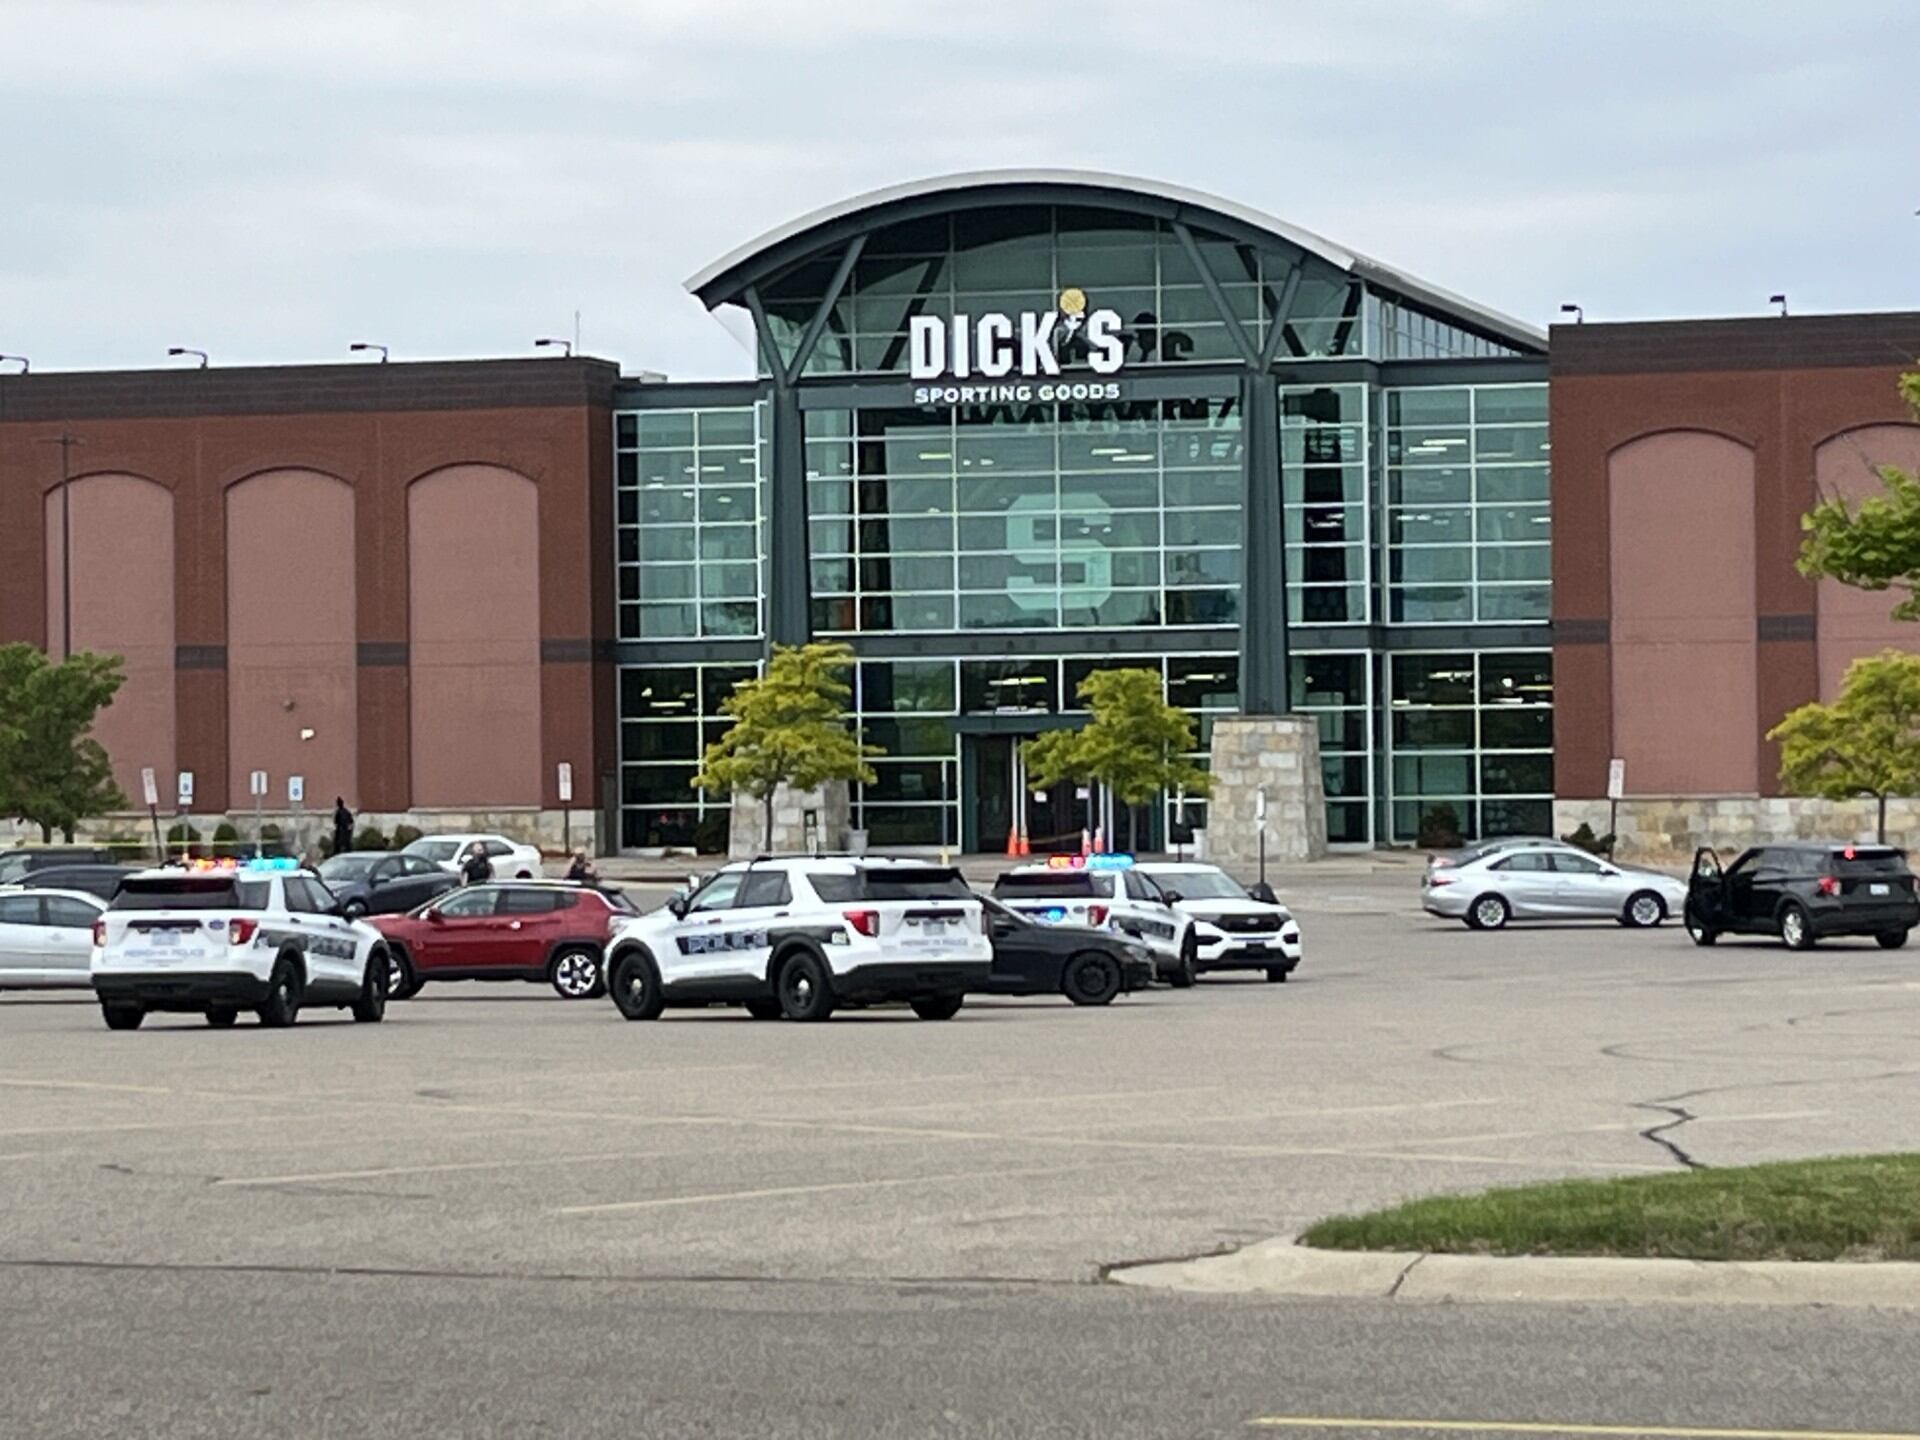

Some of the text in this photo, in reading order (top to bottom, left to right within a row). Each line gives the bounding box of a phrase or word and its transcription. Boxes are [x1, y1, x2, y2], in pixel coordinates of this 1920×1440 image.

[909, 308, 1125, 380] DICK'S
[914, 383, 1121, 404] SPORTING GOODS
[1006, 492, 1112, 610] S
